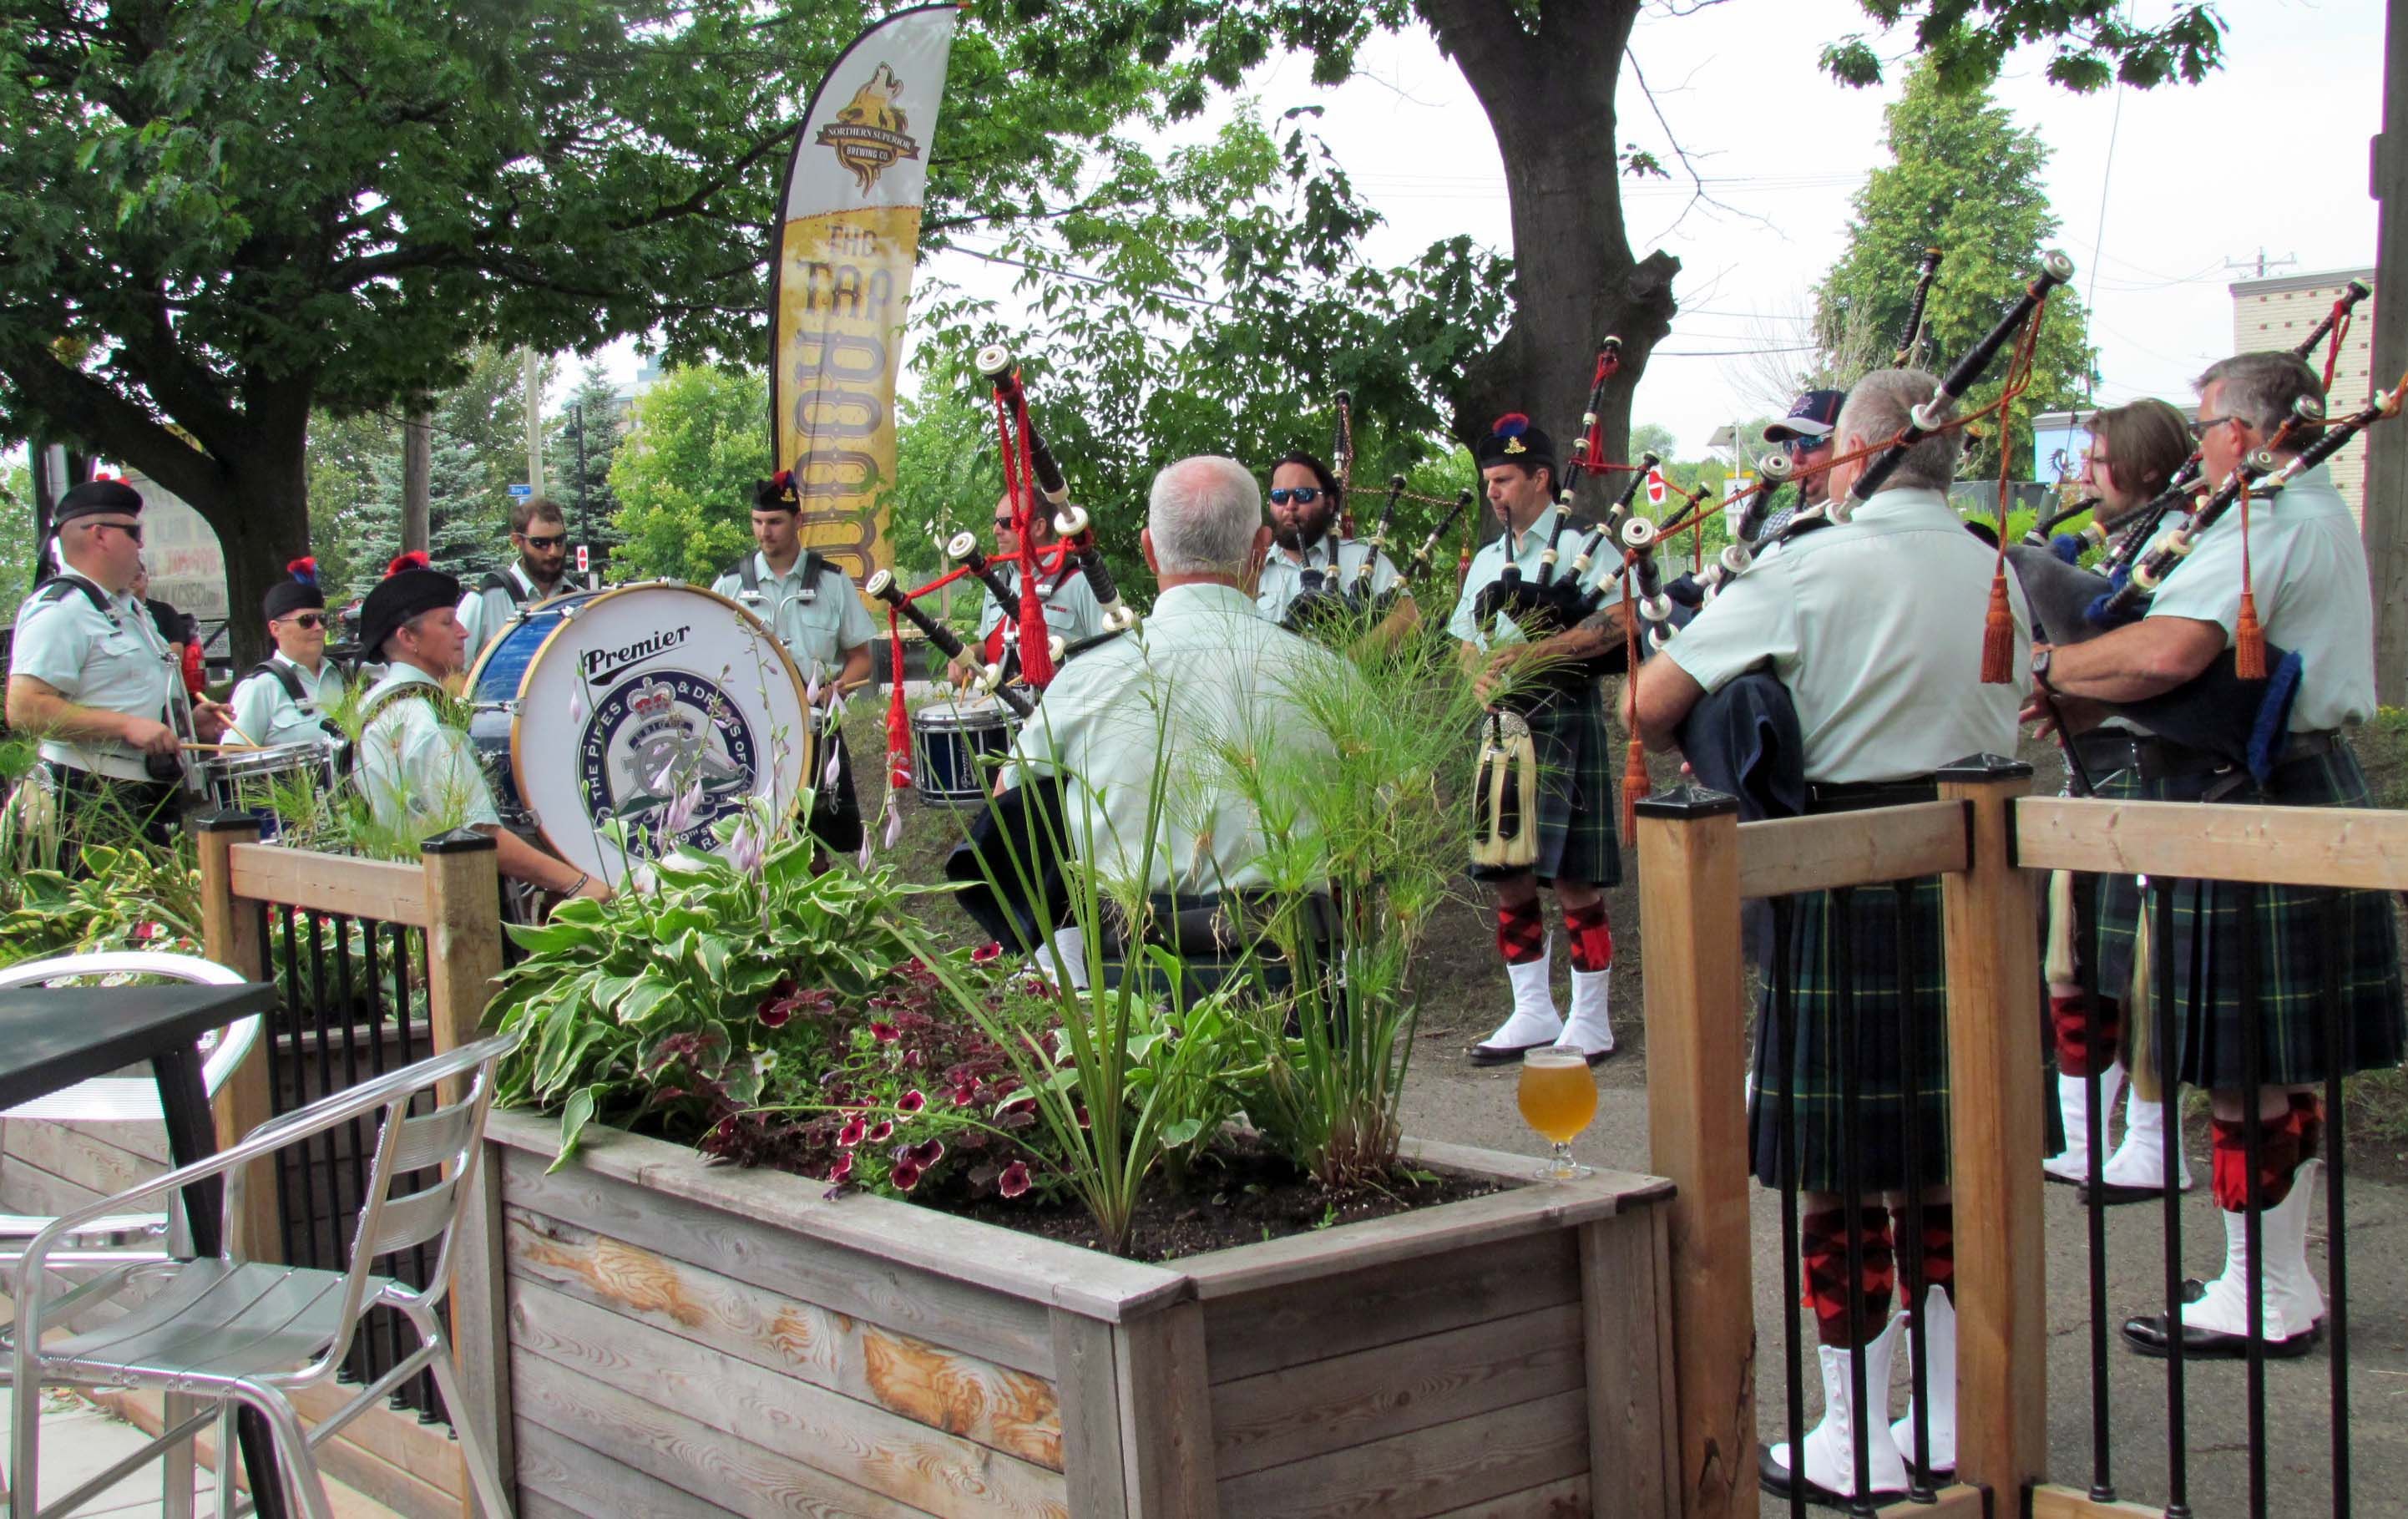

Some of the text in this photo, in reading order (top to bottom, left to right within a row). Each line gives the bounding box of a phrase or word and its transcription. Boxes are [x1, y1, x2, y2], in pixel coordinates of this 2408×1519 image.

[828, 127, 910, 149] NORTHERN SUPERIOR
[847, 146, 889, 160] BREWING CO.
[826, 225, 877, 256] THE
[797, 259, 894, 321] TAP
[584, 625, 691, 675] Premier
[589, 765, 602, 800] THE
[678, 681, 690, 695] &
[736, 742, 746, 762] OF
